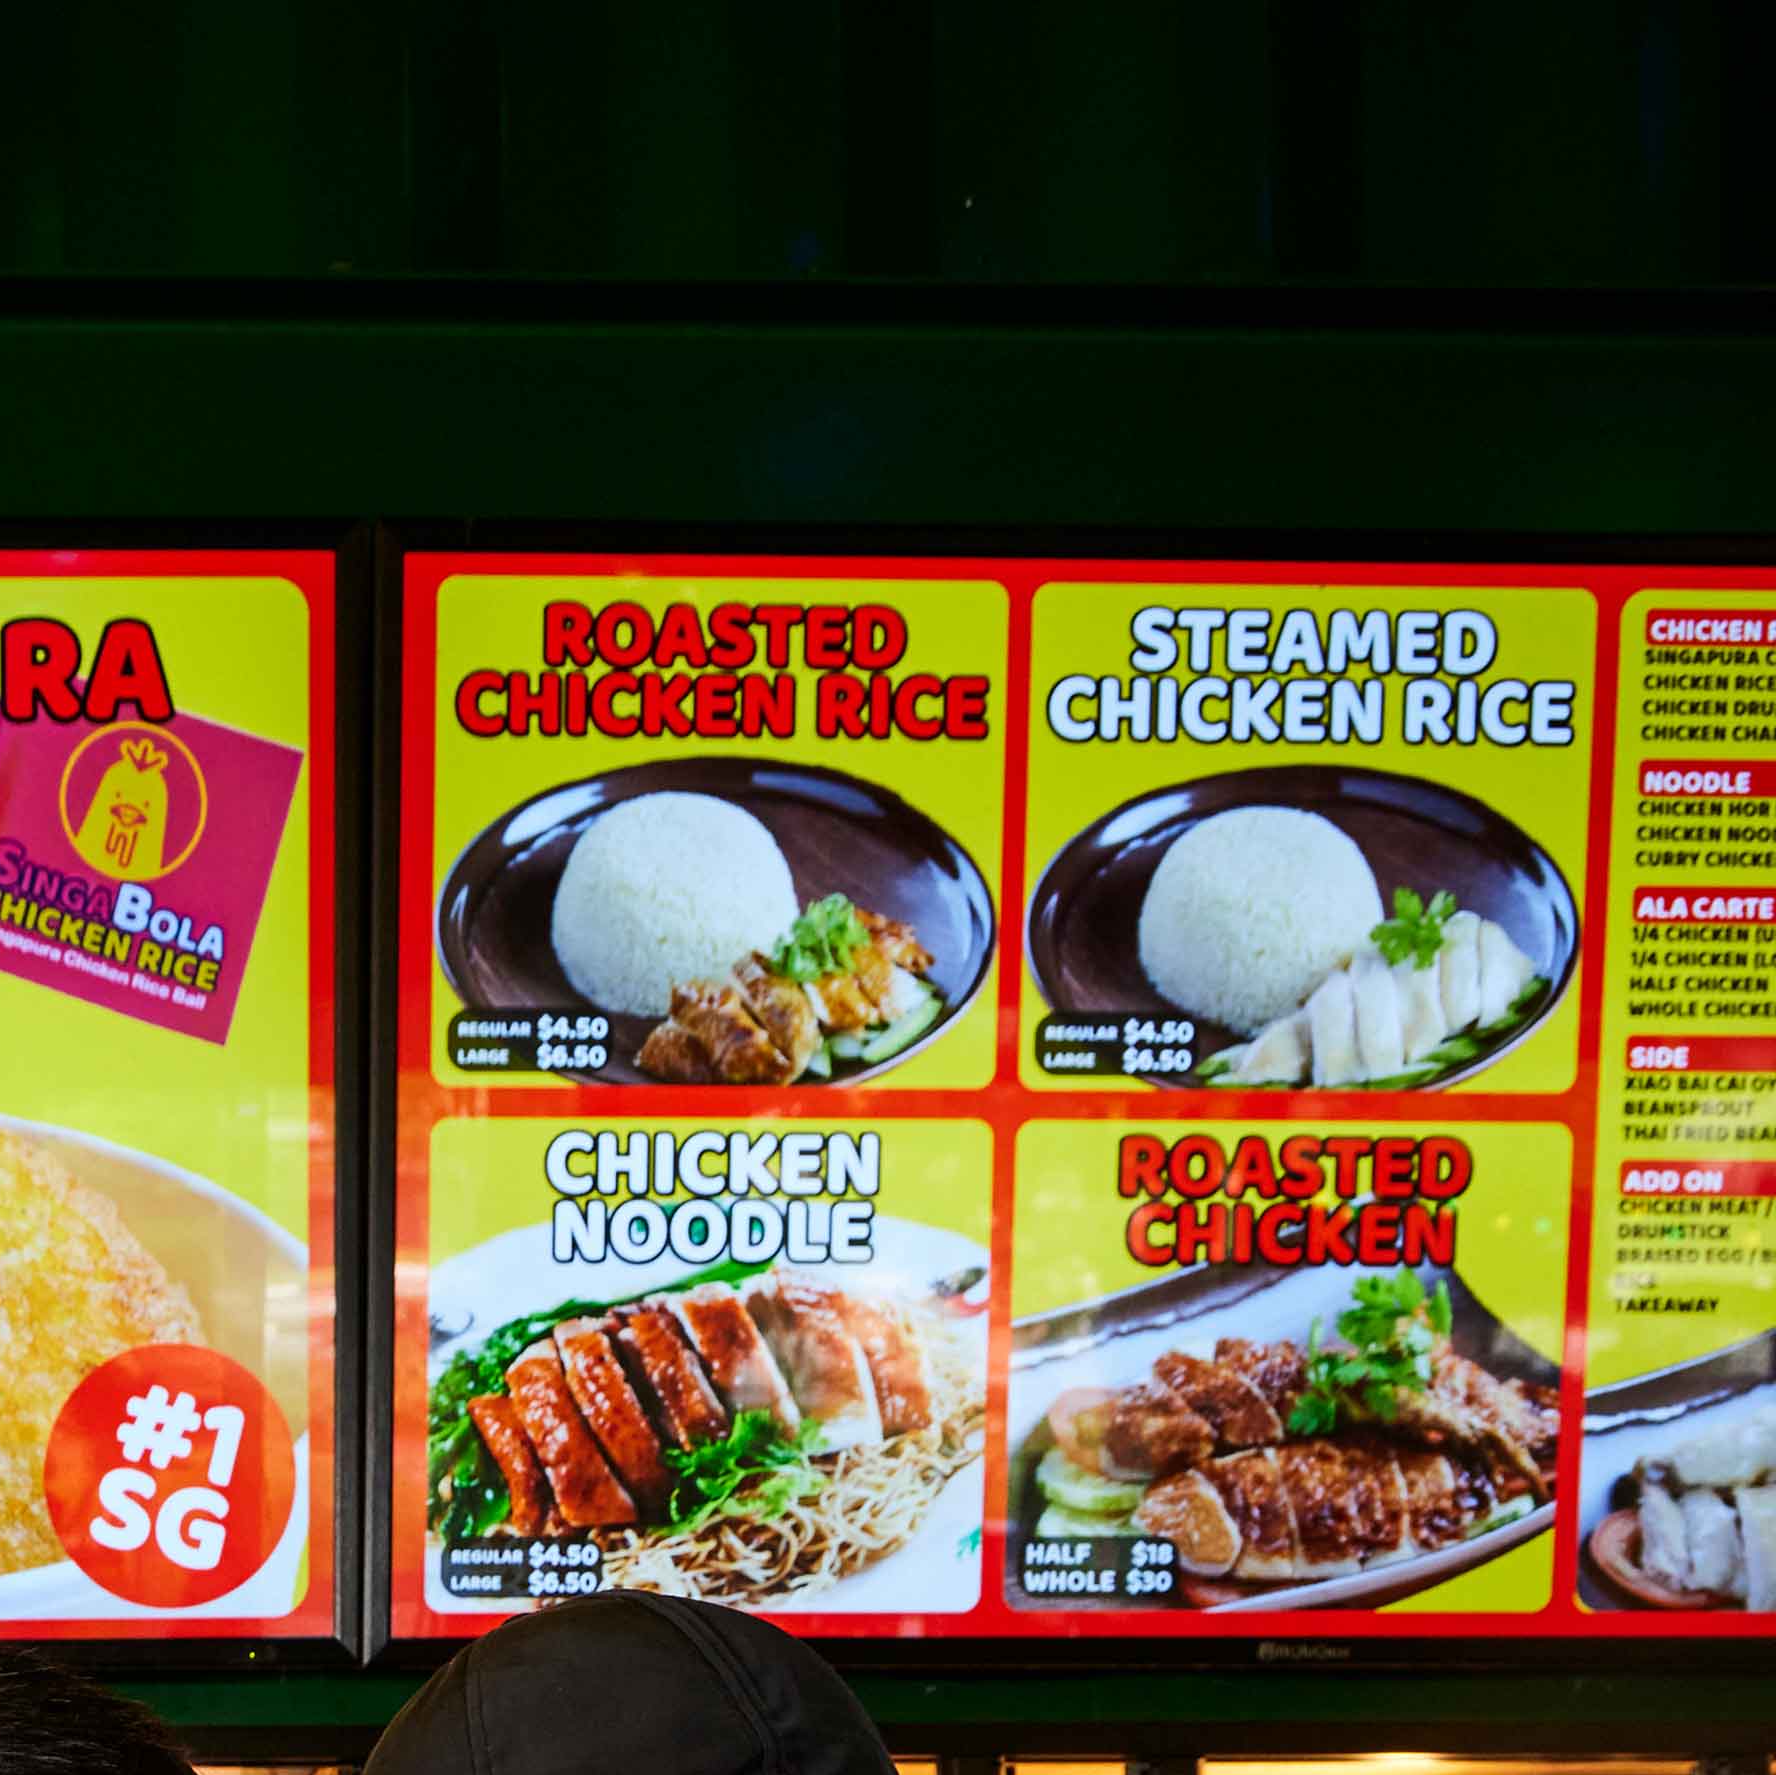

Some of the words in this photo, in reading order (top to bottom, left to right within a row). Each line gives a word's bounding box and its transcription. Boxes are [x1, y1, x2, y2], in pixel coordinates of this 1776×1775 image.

[543, 602, 907, 669] ROASTED
[1130, 605, 1498, 676] STEAMED
[1651, 619, 1762, 643] CHICKEN
[1645, 649, 1760, 666] SINGAPURA
[1643, 675, 1729, 692] CHICKEN
[456, 670, 798, 739] CHICKEN
[816, 673, 991, 742] RICE
[1047, 674, 1384, 744] CHICKEN
[1403, 678, 1576, 746] RICE
[1642, 700, 1727, 717] CHICKEN
[1733, 700, 1776, 717] DRU
[1641, 725, 1726, 742] CHICKEN
[1731, 725, 1776, 742] CHA
[1644, 771, 1751, 794] NOODLE
[1637, 801, 1722, 818] CHICKEN
[1636, 826, 1721, 843] CHICKEN
[1635, 851, 1700, 868] CURRY
[1705, 851, 1776, 868] CHICKE
[1637, 896, 1687, 919] ALA
[1692, 897, 1774, 920] CARTE
[1632, 926, 1660, 943] 1/4
[1665, 926, 1748, 942] CHICKEN
[137, 939, 220, 992] RICE
[1631, 951, 1658, 968] 1/4
[1664, 951, 1747, 968] CHICKEN
[1629, 976, 1678, 993] HALF
[1684, 977, 1769, 993] CHICKEN
[1628, 1001, 1698, 1018] WHOLE
[1704, 1001, 1776, 1018] CHICKE
[457, 1021, 532, 1039] REGULAR
[537, 1014, 609, 1043] $4.50
[1044, 1024, 1117, 1042] REGULAR
[1124, 1018, 1194, 1046] $4.50
[457, 1047, 510, 1067] LARGE
[536, 1042, 607, 1073] $6.50
[1044, 1050, 1096, 1070] LARGE
[1123, 1045, 1192, 1074] $6.50
[1629, 1045, 1690, 1069] SIDE
[1715, 1076, 1747, 1092] CAI
[1624, 1101, 1756, 1118] BEANSPROUT
[1623, 1125, 1668, 1142] THAI
[1735, 1125, 1776, 1142] BEA
[546, 1130, 881, 1198] CHICKEN
[1118, 1135, 1473, 1201] ROASTED
[1624, 1170, 1680, 1193] ADD
[1682, 1170, 1724, 1193] ON
[1618, 1199, 1703, 1217] CHICKEN
[1708, 1199, 1761, 1217] MEAT
[553, 1198, 874, 1265] NOODLE
[1125, 1202, 1457, 1267] CHICKEN
[1618, 1224, 1729, 1241] DRUMSTICK
[1615, 1297, 1719, 1314] TAKEAWAY
[116, 1383, 246, 1486] #1
[89, 1470, 229, 1571] SG
[451, 1548, 523, 1566] REGULAR
[529, 1542, 599, 1570] $4.50
[1025, 1543, 1091, 1567] HALF
[1132, 1540, 1174, 1569] $18
[450, 1574, 502, 1593] LARGE
[528, 1569, 598, 1597] $6.50
[1024, 1569, 1116, 1594] WHOLE
[1126, 1567, 1172, 1596] $30
